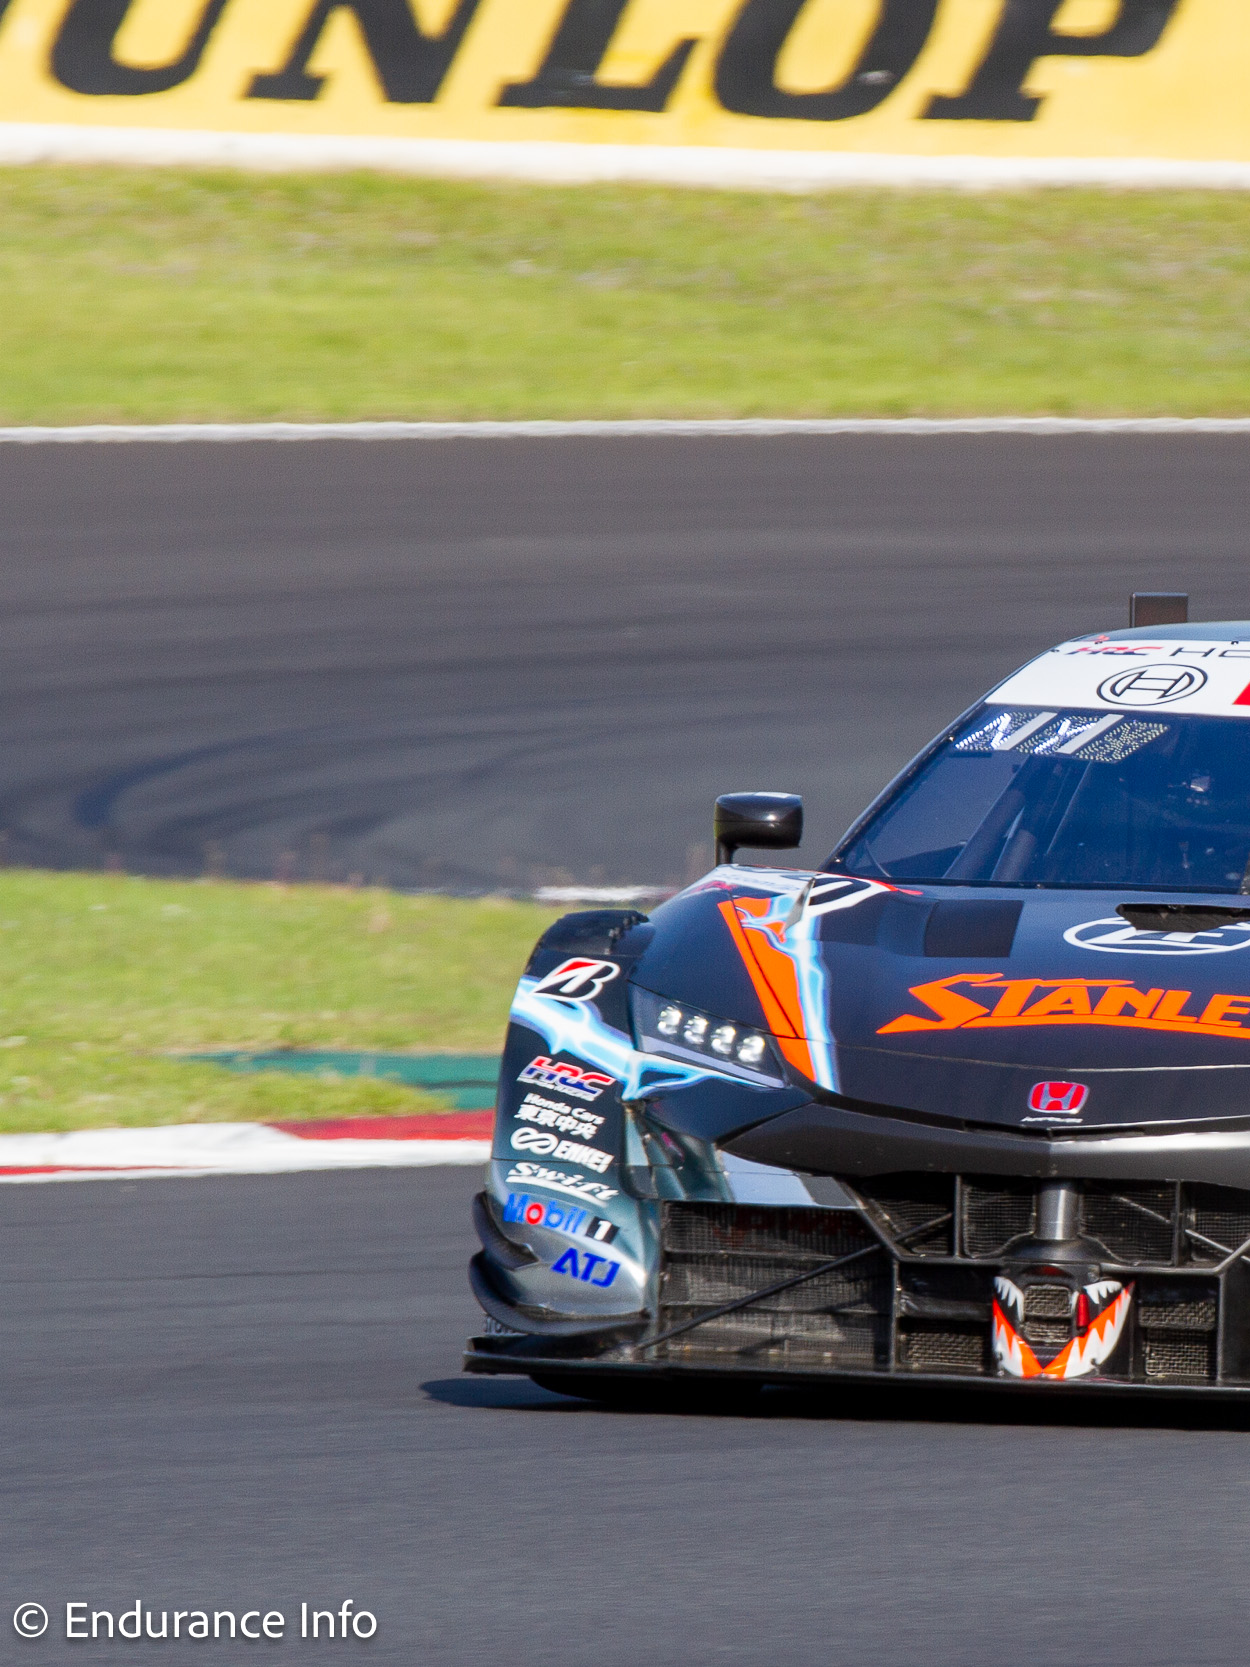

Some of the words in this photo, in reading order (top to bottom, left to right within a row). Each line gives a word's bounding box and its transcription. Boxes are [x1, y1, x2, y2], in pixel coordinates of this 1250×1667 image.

[0, 0, 1178, 122] UNLOP
[518, 1056, 616, 1098] HRC
[503, 1193, 587, 1234] Mobil
[551, 1247, 621, 1288] ATJ
